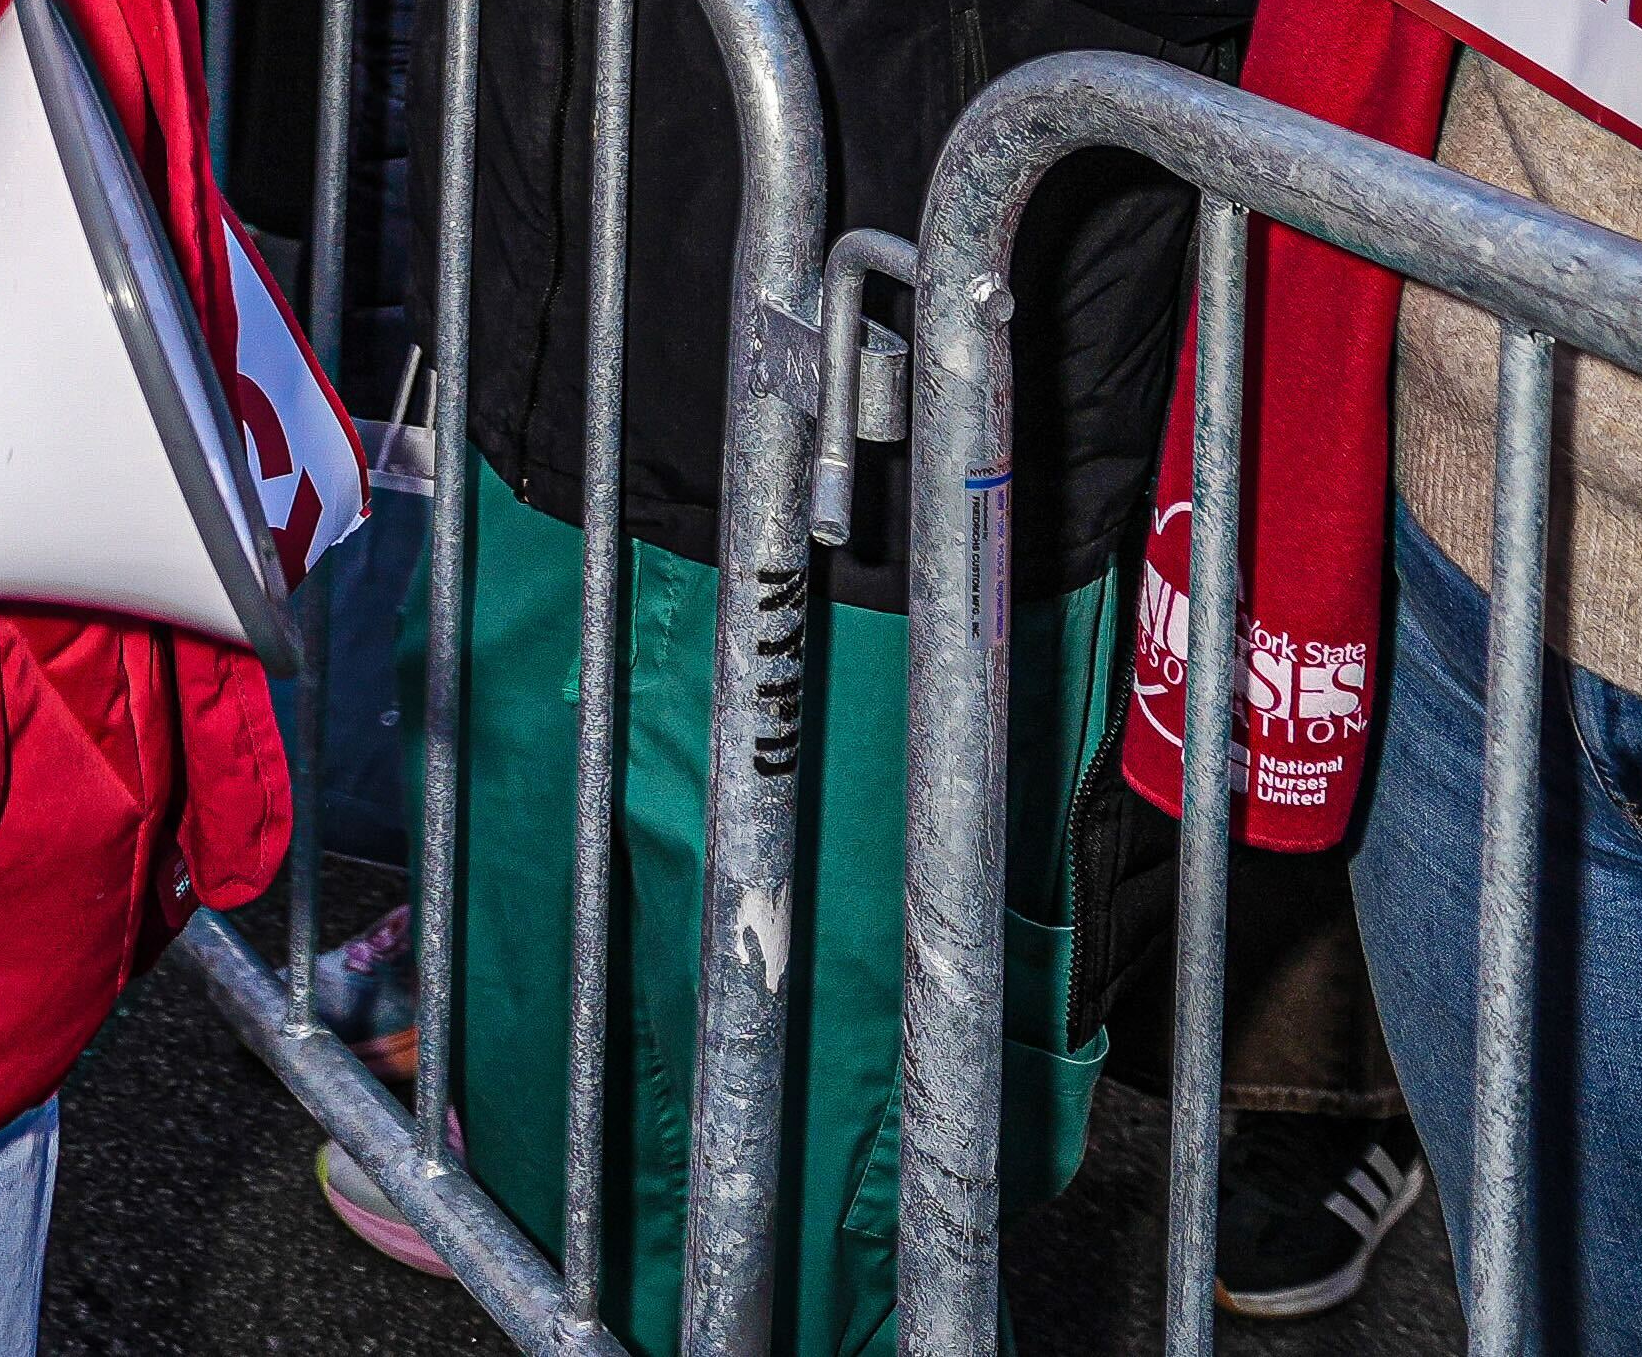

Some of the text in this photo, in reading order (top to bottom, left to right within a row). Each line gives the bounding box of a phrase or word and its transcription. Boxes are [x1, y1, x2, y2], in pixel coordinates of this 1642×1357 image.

[972, 552, 981, 590] CUSTOM
[1304, 641, 1367, 665] State
[1259, 753, 1343, 775] National
[1257, 771, 1328, 791] Nurses
[1256, 786, 1326, 806] United
